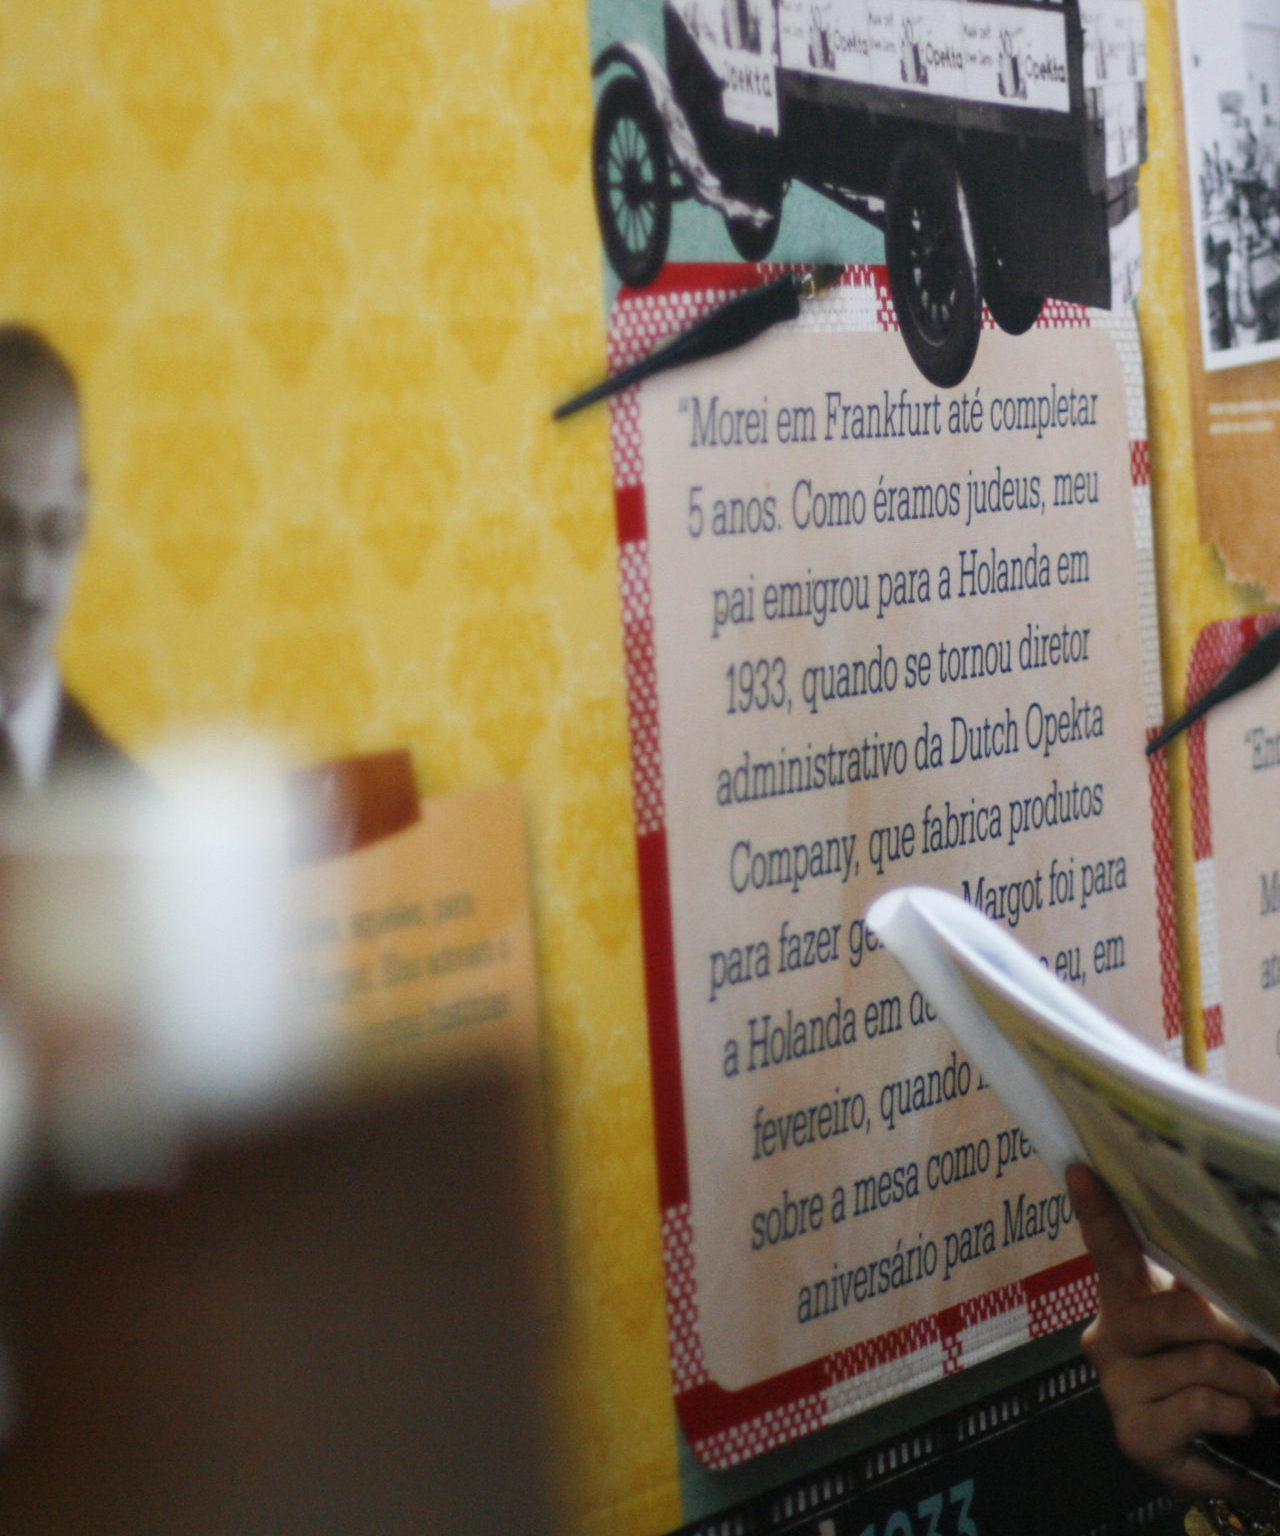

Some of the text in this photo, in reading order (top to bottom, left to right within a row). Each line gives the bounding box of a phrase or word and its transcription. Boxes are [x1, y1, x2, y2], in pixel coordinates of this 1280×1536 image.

[679, 382, 1099, 448] “Morei em Frankfurt até completar
[687, 465, 1100, 539] 5 anos. Como éramos judeus, meu
[711, 542, 1091, 639] pai emigrou para a Holanda em
[725, 623, 1091, 715] 1933, quando se tornou diretor
[716, 696, 1105, 807] administrativo da Dutch Opekta
[729, 779, 1104, 893] Company, que fabrica produtos
[1048, 856, 1076, 911] foi
[1080, 854, 1128, 916] para
[708, 943, 770, 1001] para
[777, 921, 840, 973] fazer
[1055, 935, 1126, 985] eu, em
[723, 1035, 740, 1078] a
[746, 996, 857, 1072] Holanda
[864, 994, 901, 1040] em
[751, 1050, 972, 1162] fevereiro, quando
[751, 1178, 825, 1252] sobre
[830, 1186, 847, 1224] a
[853, 1162, 919, 1218] mesa
[926, 1134, 990, 1192] como
[797, 1190, 1075, 1325] aniversário para Margo
